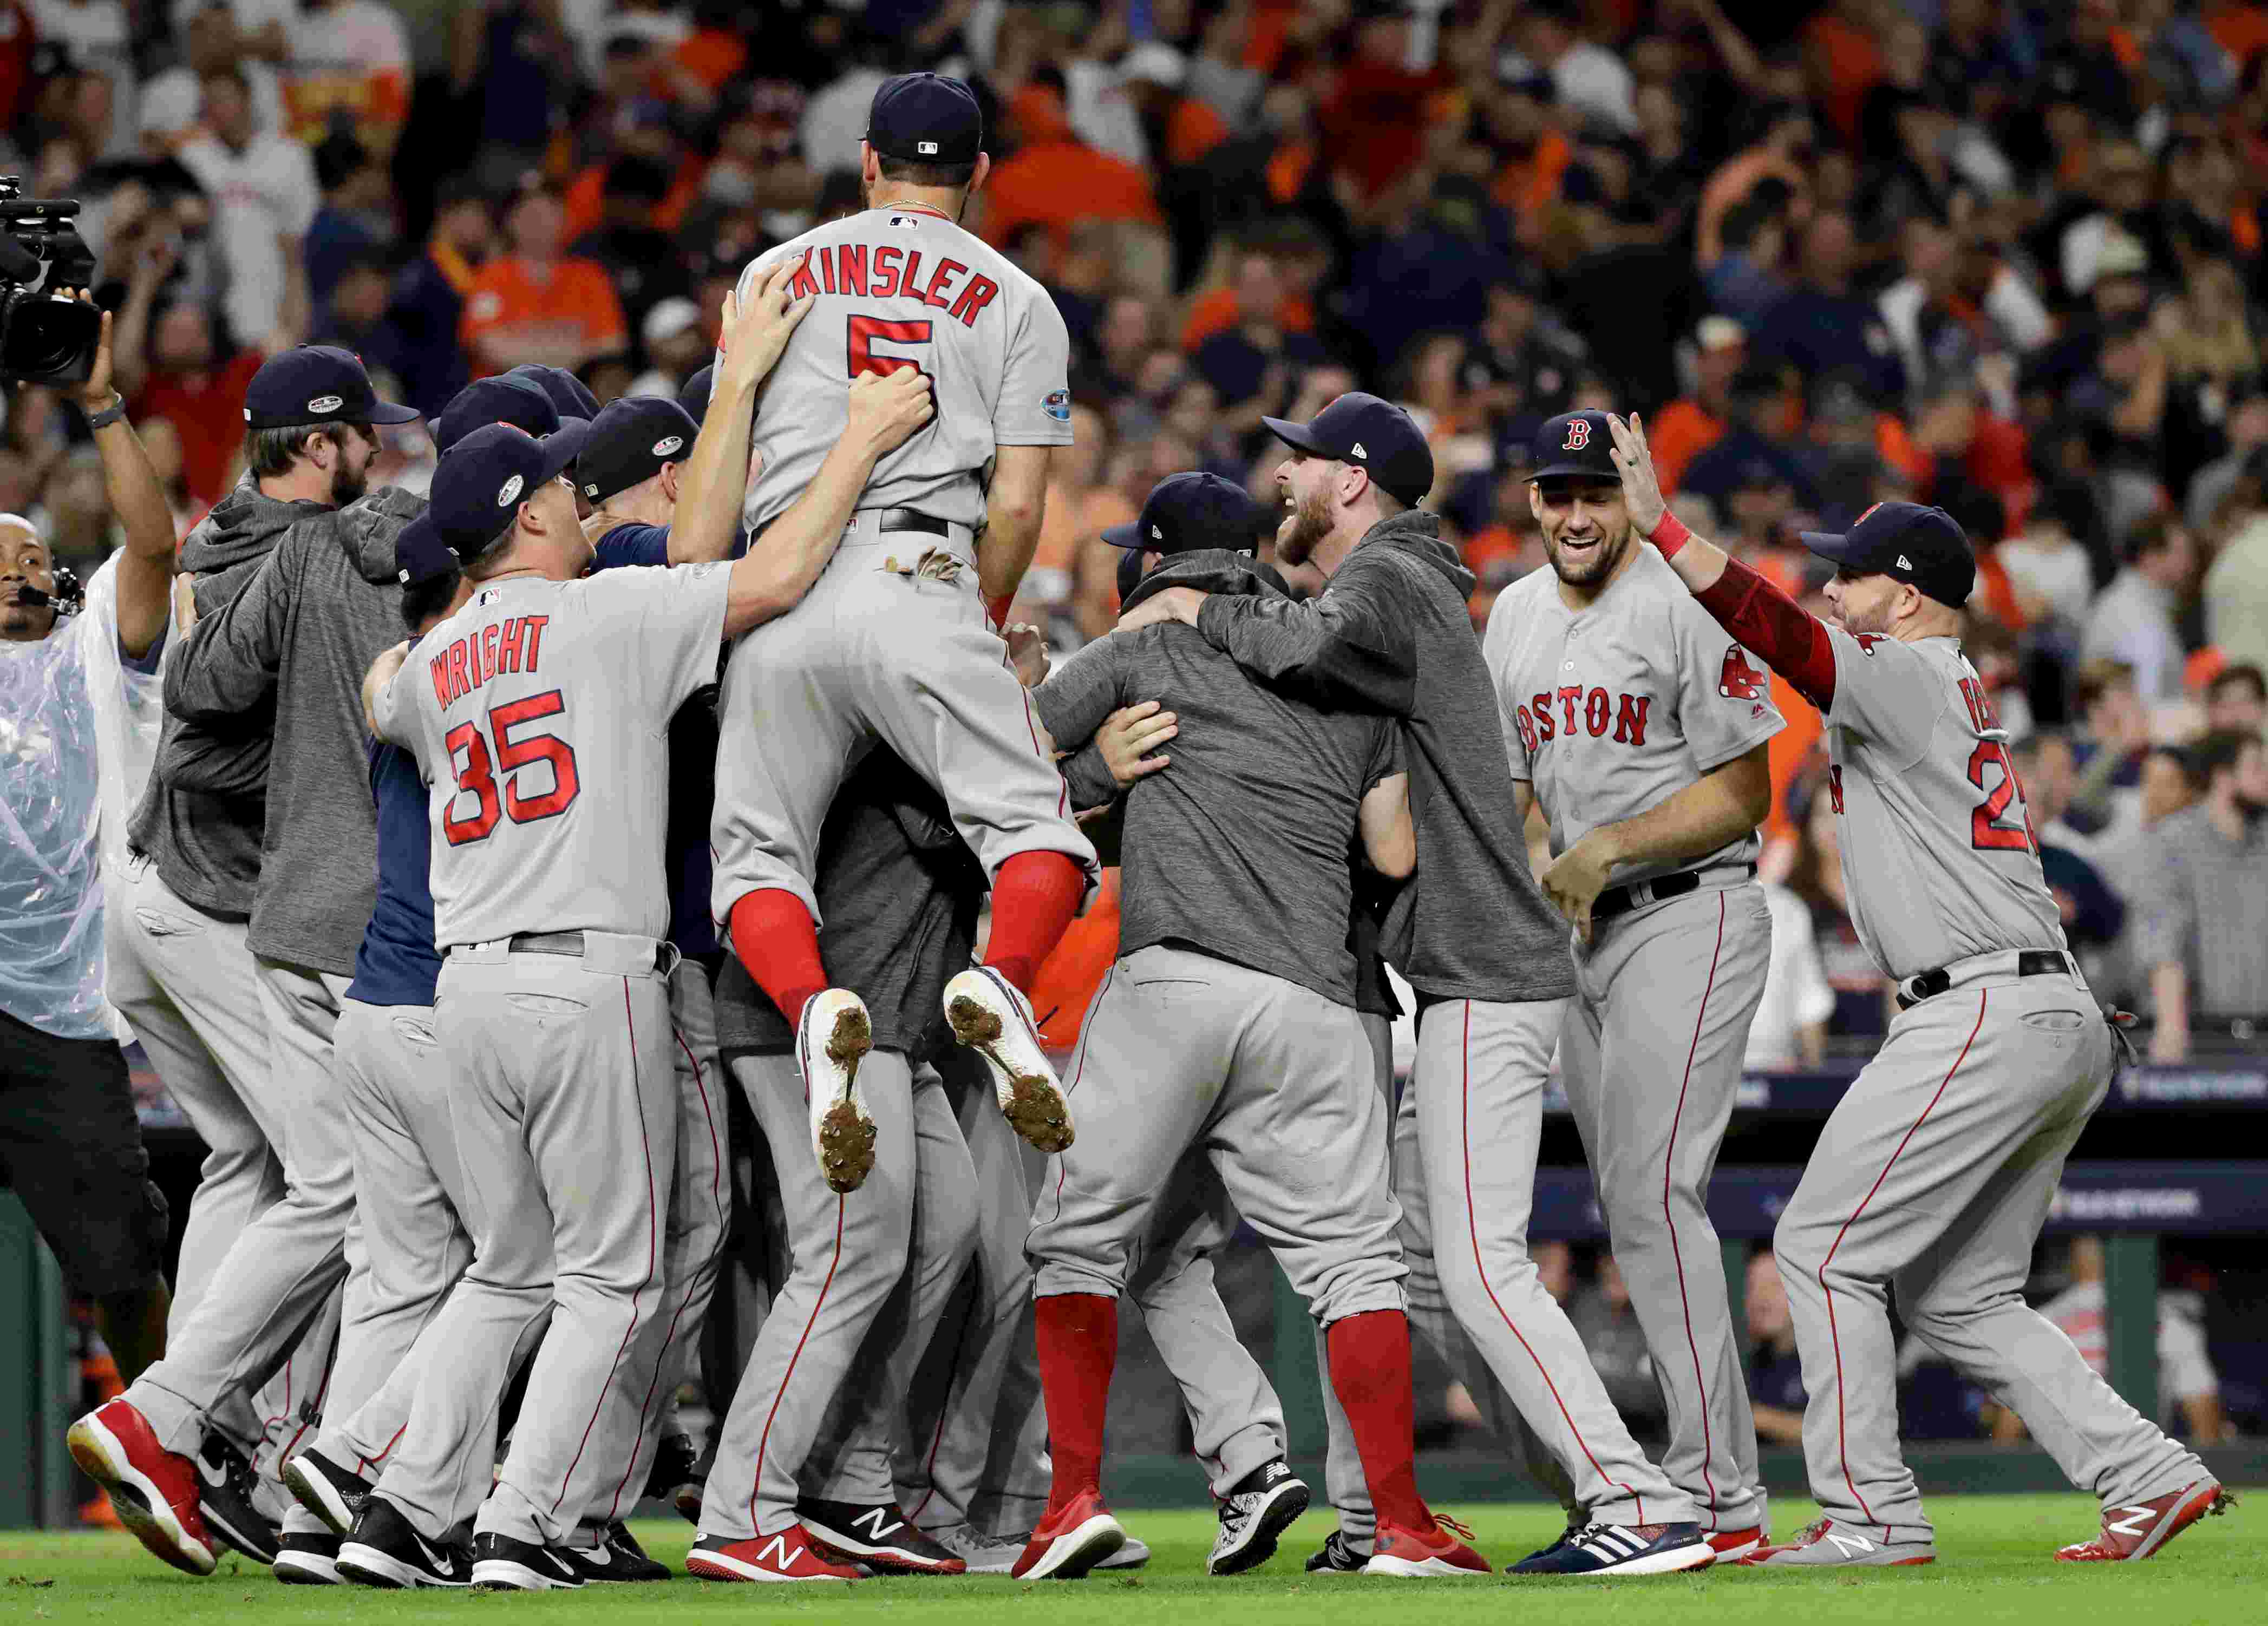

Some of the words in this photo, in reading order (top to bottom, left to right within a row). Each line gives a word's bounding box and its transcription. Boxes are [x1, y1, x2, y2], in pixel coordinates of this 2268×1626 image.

[792, 244, 999, 329] KINSLER
[847, 313, 940, 429] 5
[1562, 419, 1592, 450] B
[429, 614, 550, 712] WRIGHT
[1517, 684, 1651, 752] OSTON
[443, 689, 581, 848] 35
[756, 1535, 805, 1571] N
[851, 1507, 905, 1540] N
[1826, 1533, 1875, 1559] N
